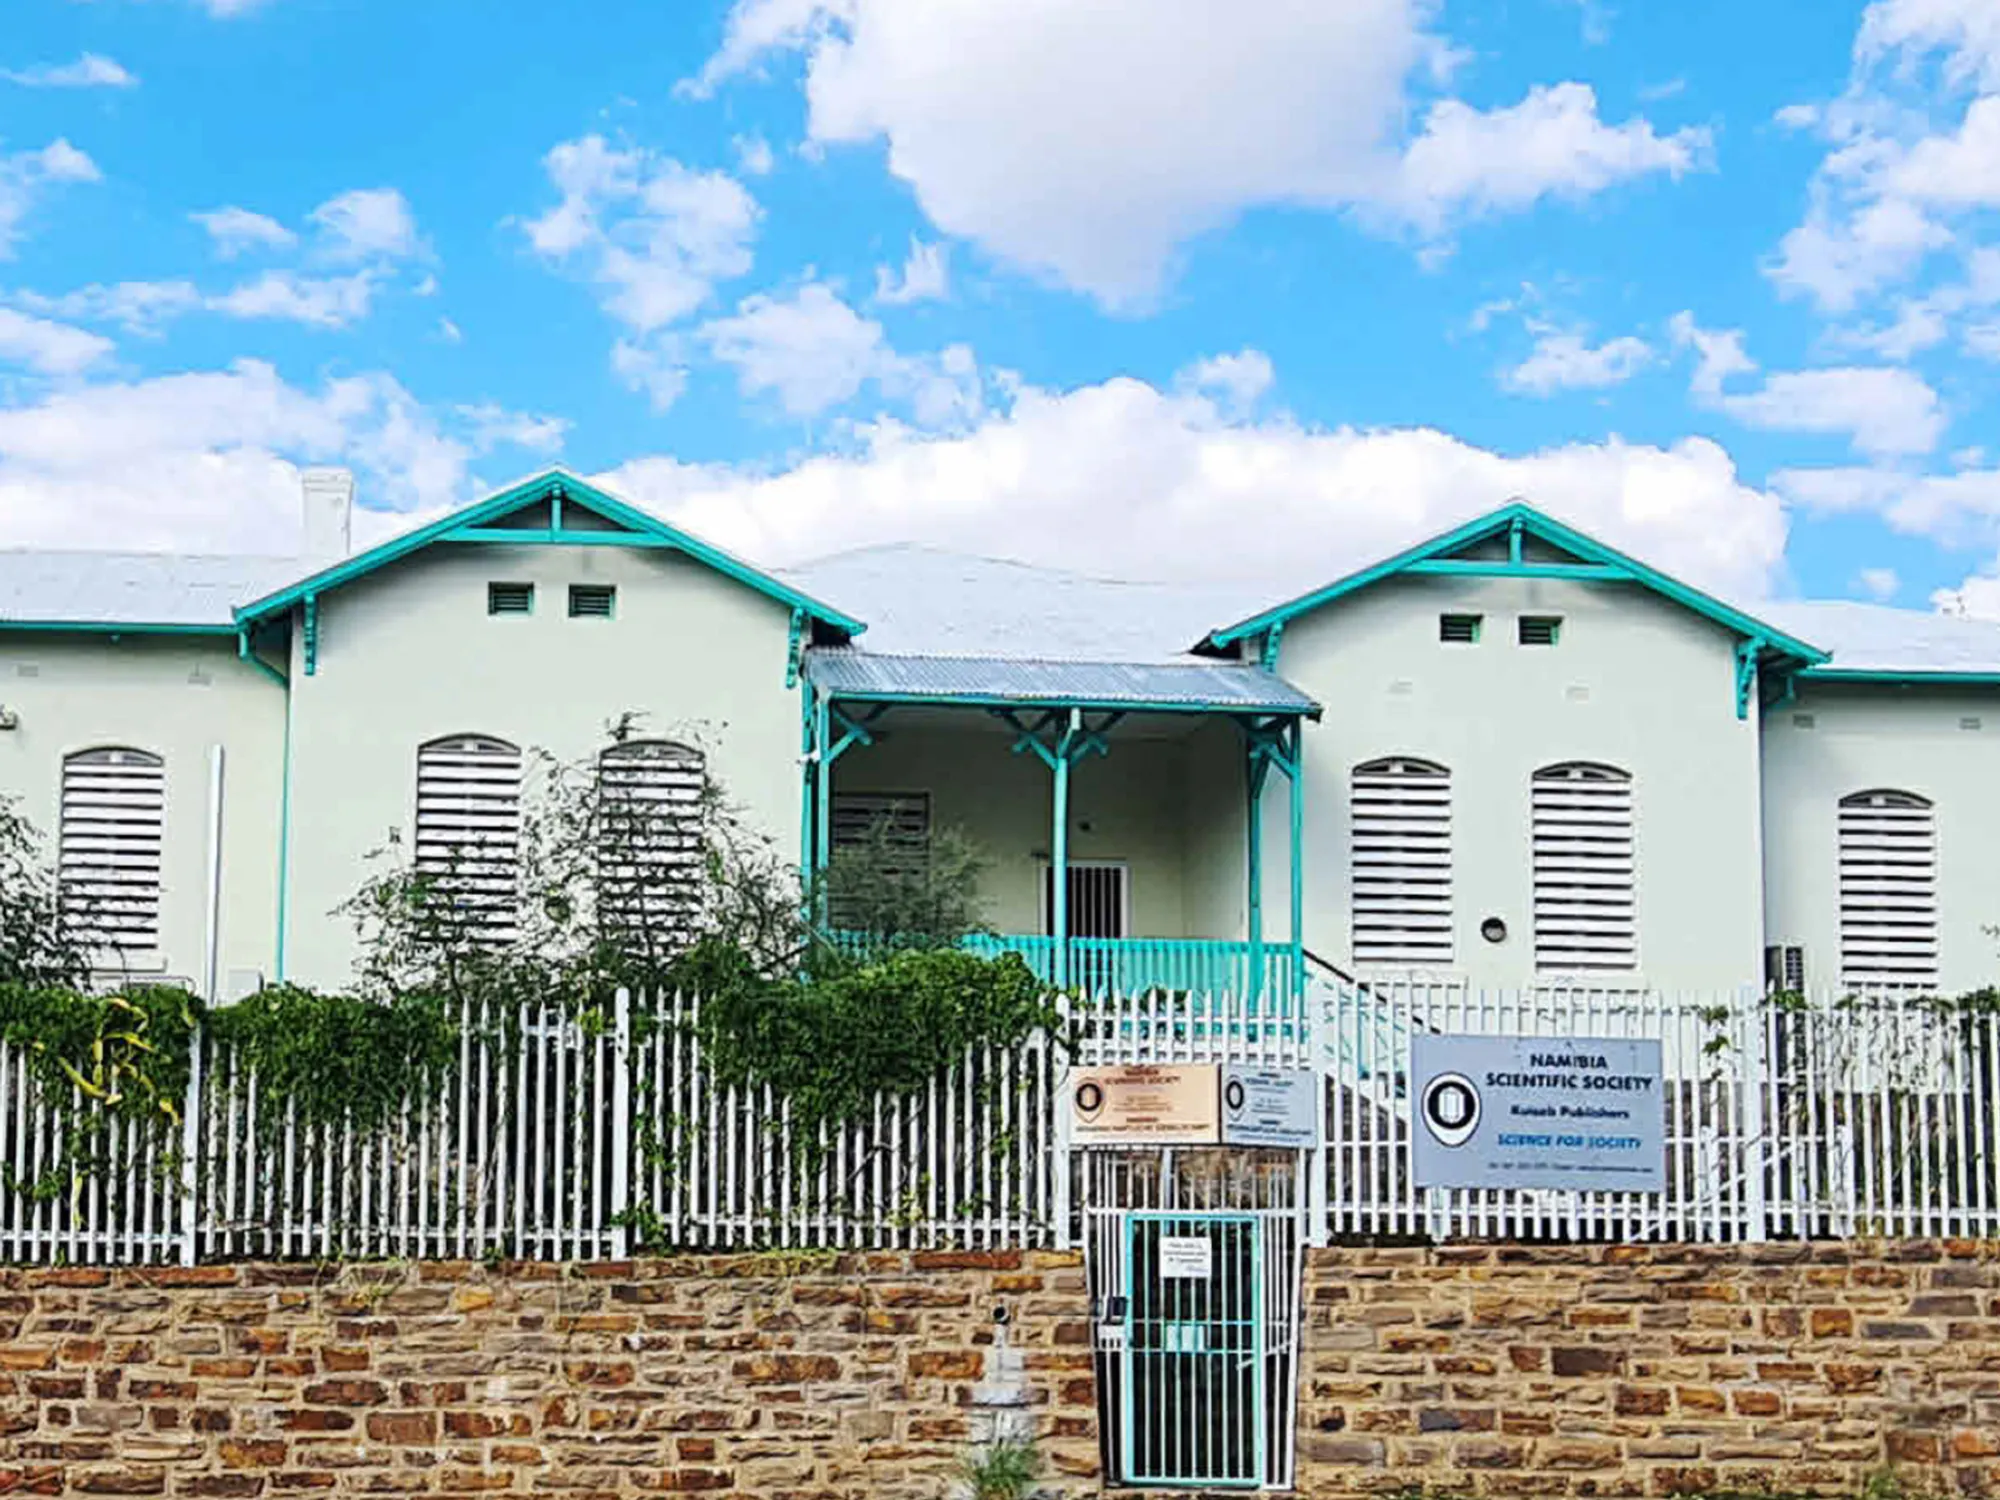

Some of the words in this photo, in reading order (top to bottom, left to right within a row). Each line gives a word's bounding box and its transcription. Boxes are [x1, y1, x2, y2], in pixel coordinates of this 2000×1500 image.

[1530, 1054, 1608, 1069] NAMIBIA
[1486, 1073, 1579, 1088] SCIENTIFIC
[1582, 1075, 1653, 1090] SOCIETY
[1560, 1105, 1630, 1118] Publishers
[1498, 1133, 1552, 1146] SCIENCE
[1556, 1134, 1583, 1147] FOR
[1588, 1136, 1641, 1149] SOCIETY
